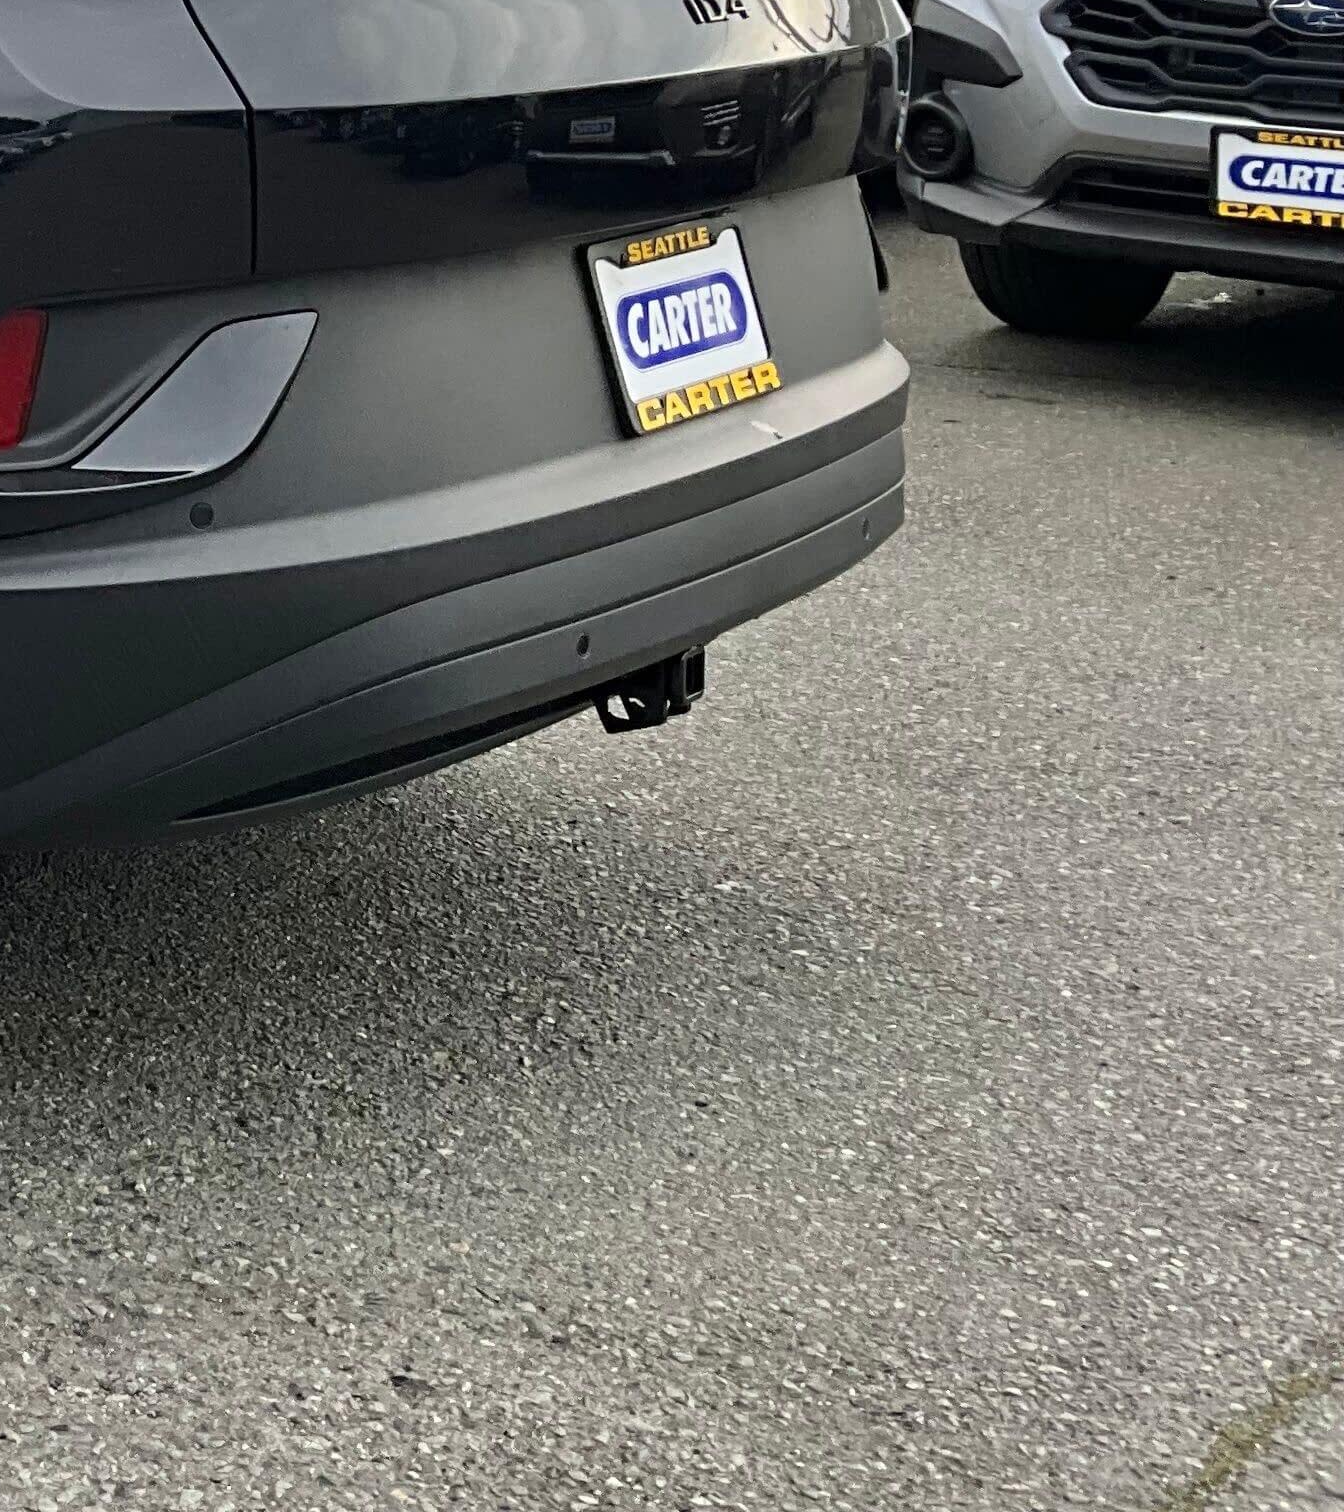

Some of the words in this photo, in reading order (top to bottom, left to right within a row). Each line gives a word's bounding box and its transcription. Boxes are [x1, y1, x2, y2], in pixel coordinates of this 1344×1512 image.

[1218, 201, 1344, 228] CART
[627, 226, 710, 263] SEATTLE
[627, 283, 736, 358] CARTER
[636, 361, 781, 431] CARTER
